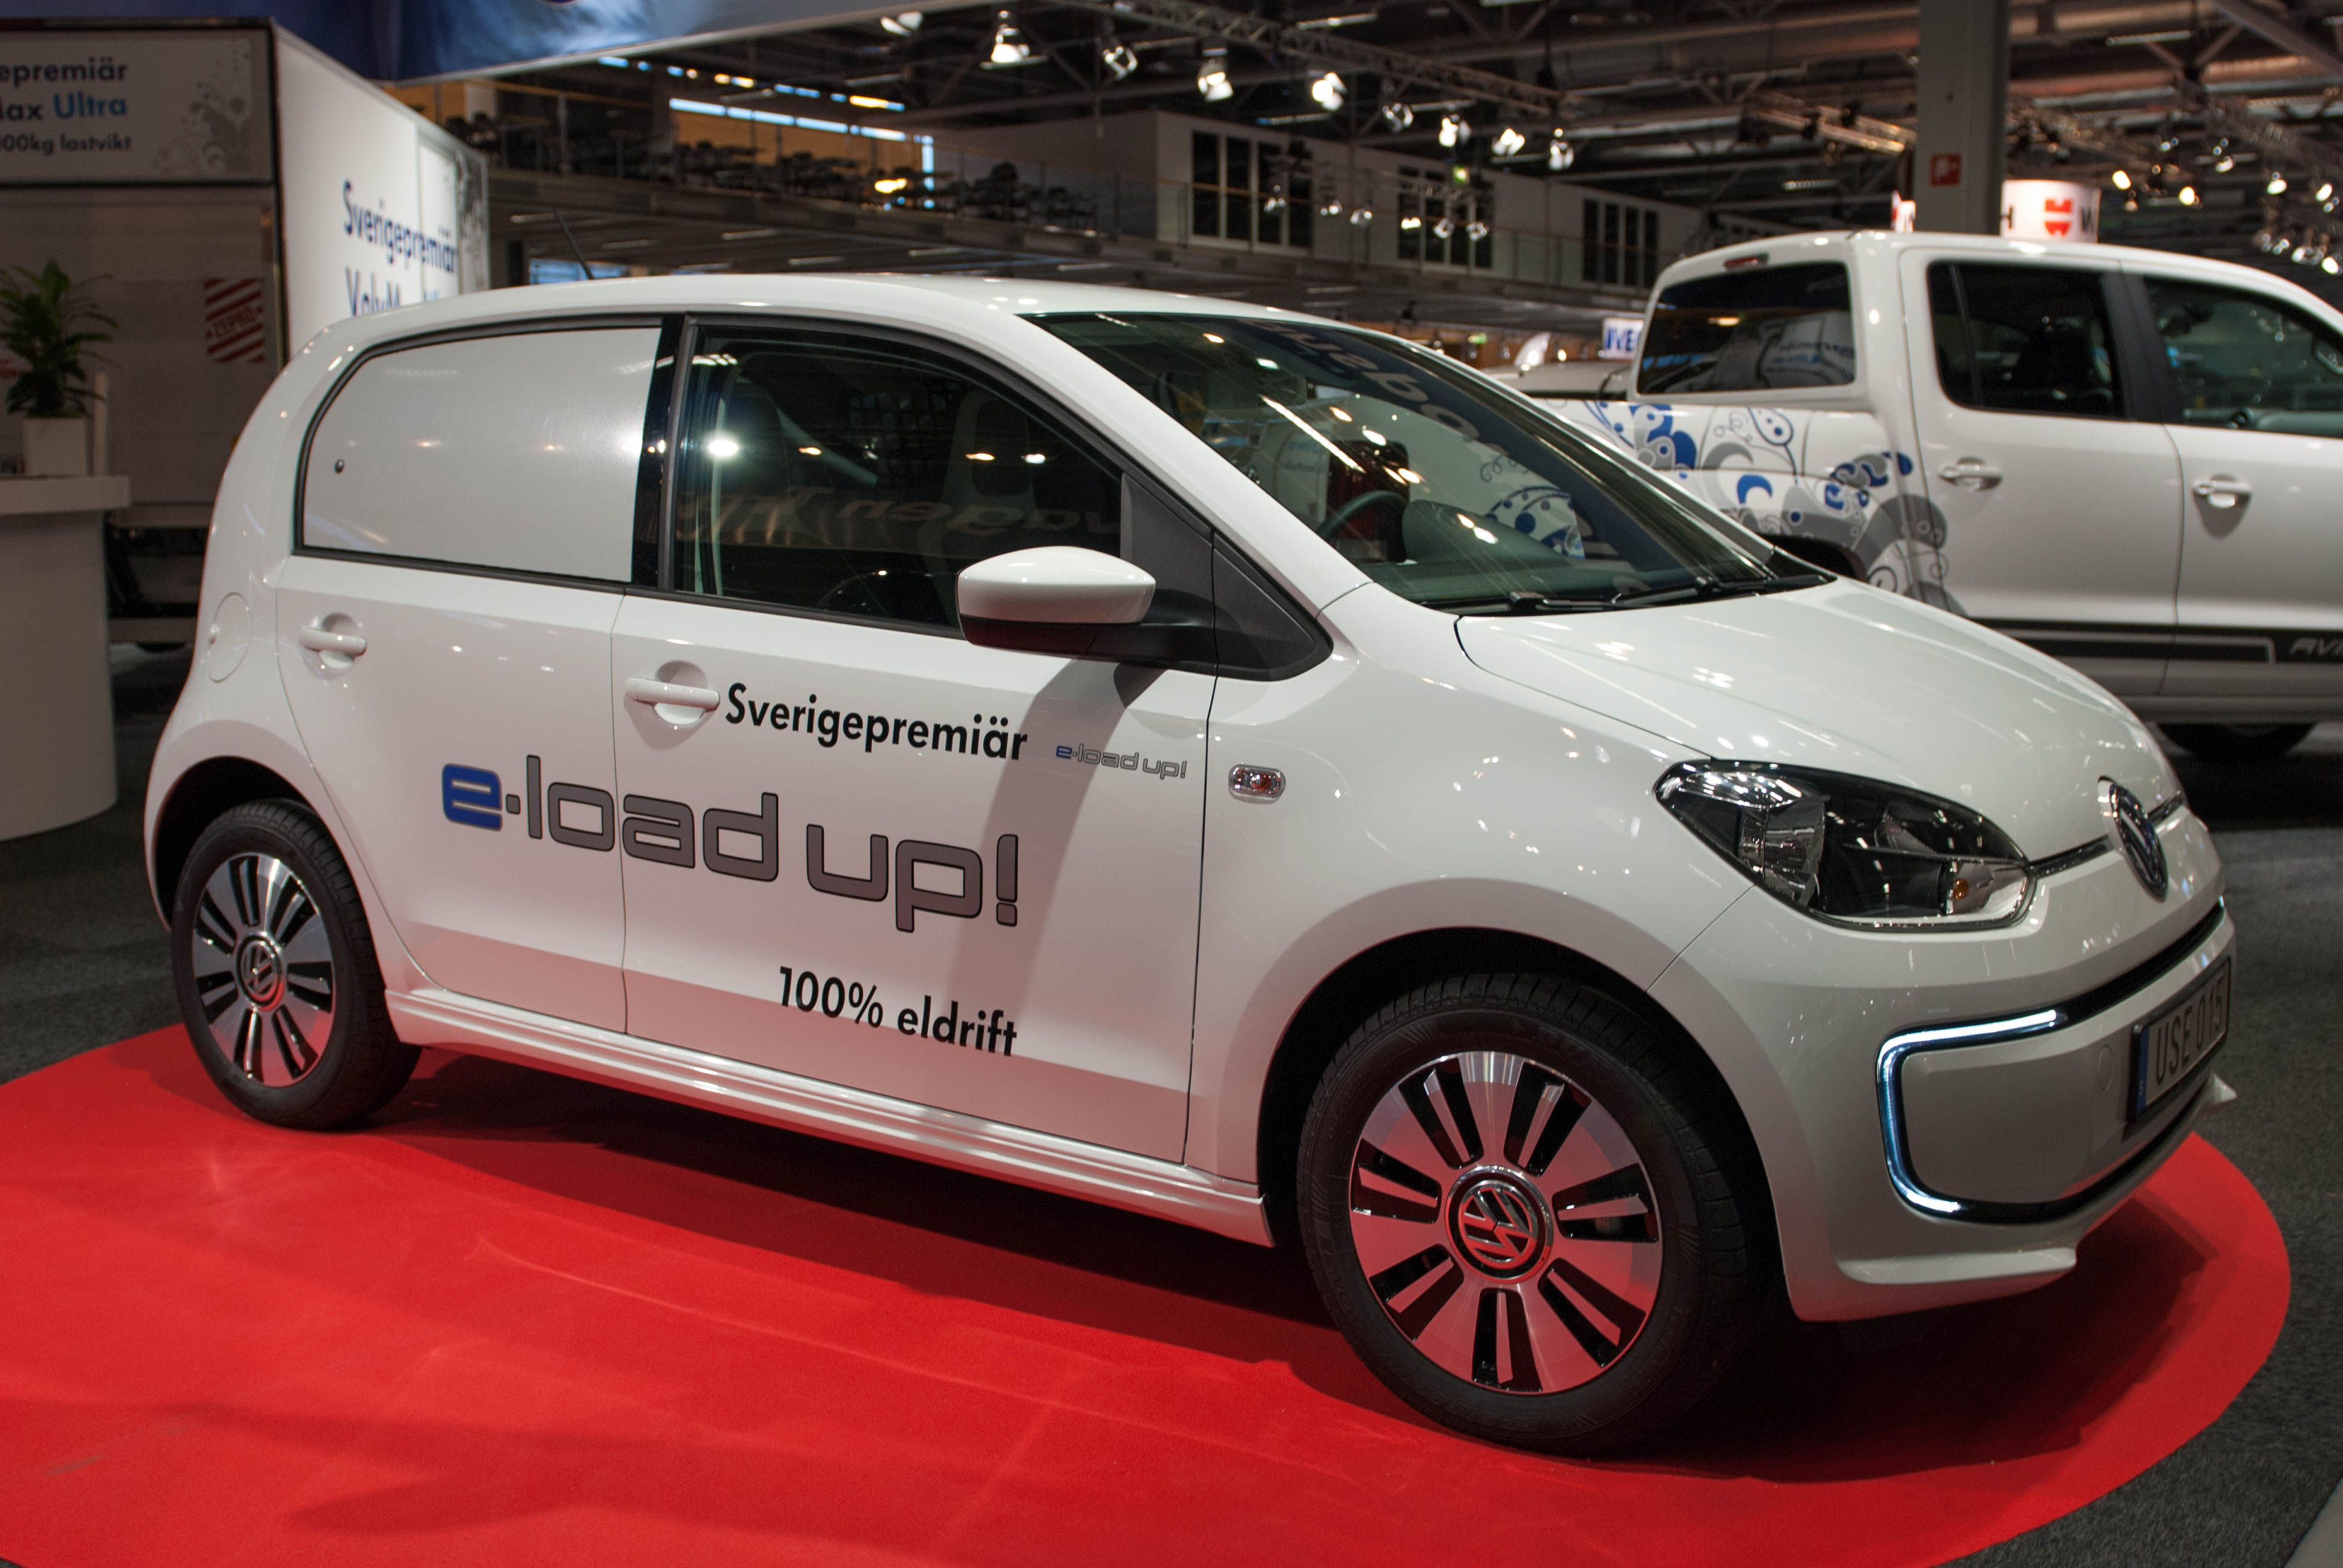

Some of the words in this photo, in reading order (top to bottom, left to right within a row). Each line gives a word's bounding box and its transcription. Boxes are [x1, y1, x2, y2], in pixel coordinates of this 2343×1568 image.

[0, 96, 43, 120] ax
[53, 91, 127, 119] Ultra
[0, 131, 54, 156] 00kg
[342, 178, 458, 275] Sverigepremiär
[1604, 327, 1642, 352] IVE
[726, 682, 1028, 761] Sverigepremiär
[1142, 757, 1187, 780] up!
[805, 823, 1019, 933] up!
[779, 965, 883, 1028] 100%
[897, 995, 1017, 1057] eldrift
[2155, 1005, 2194, 1086] USE
